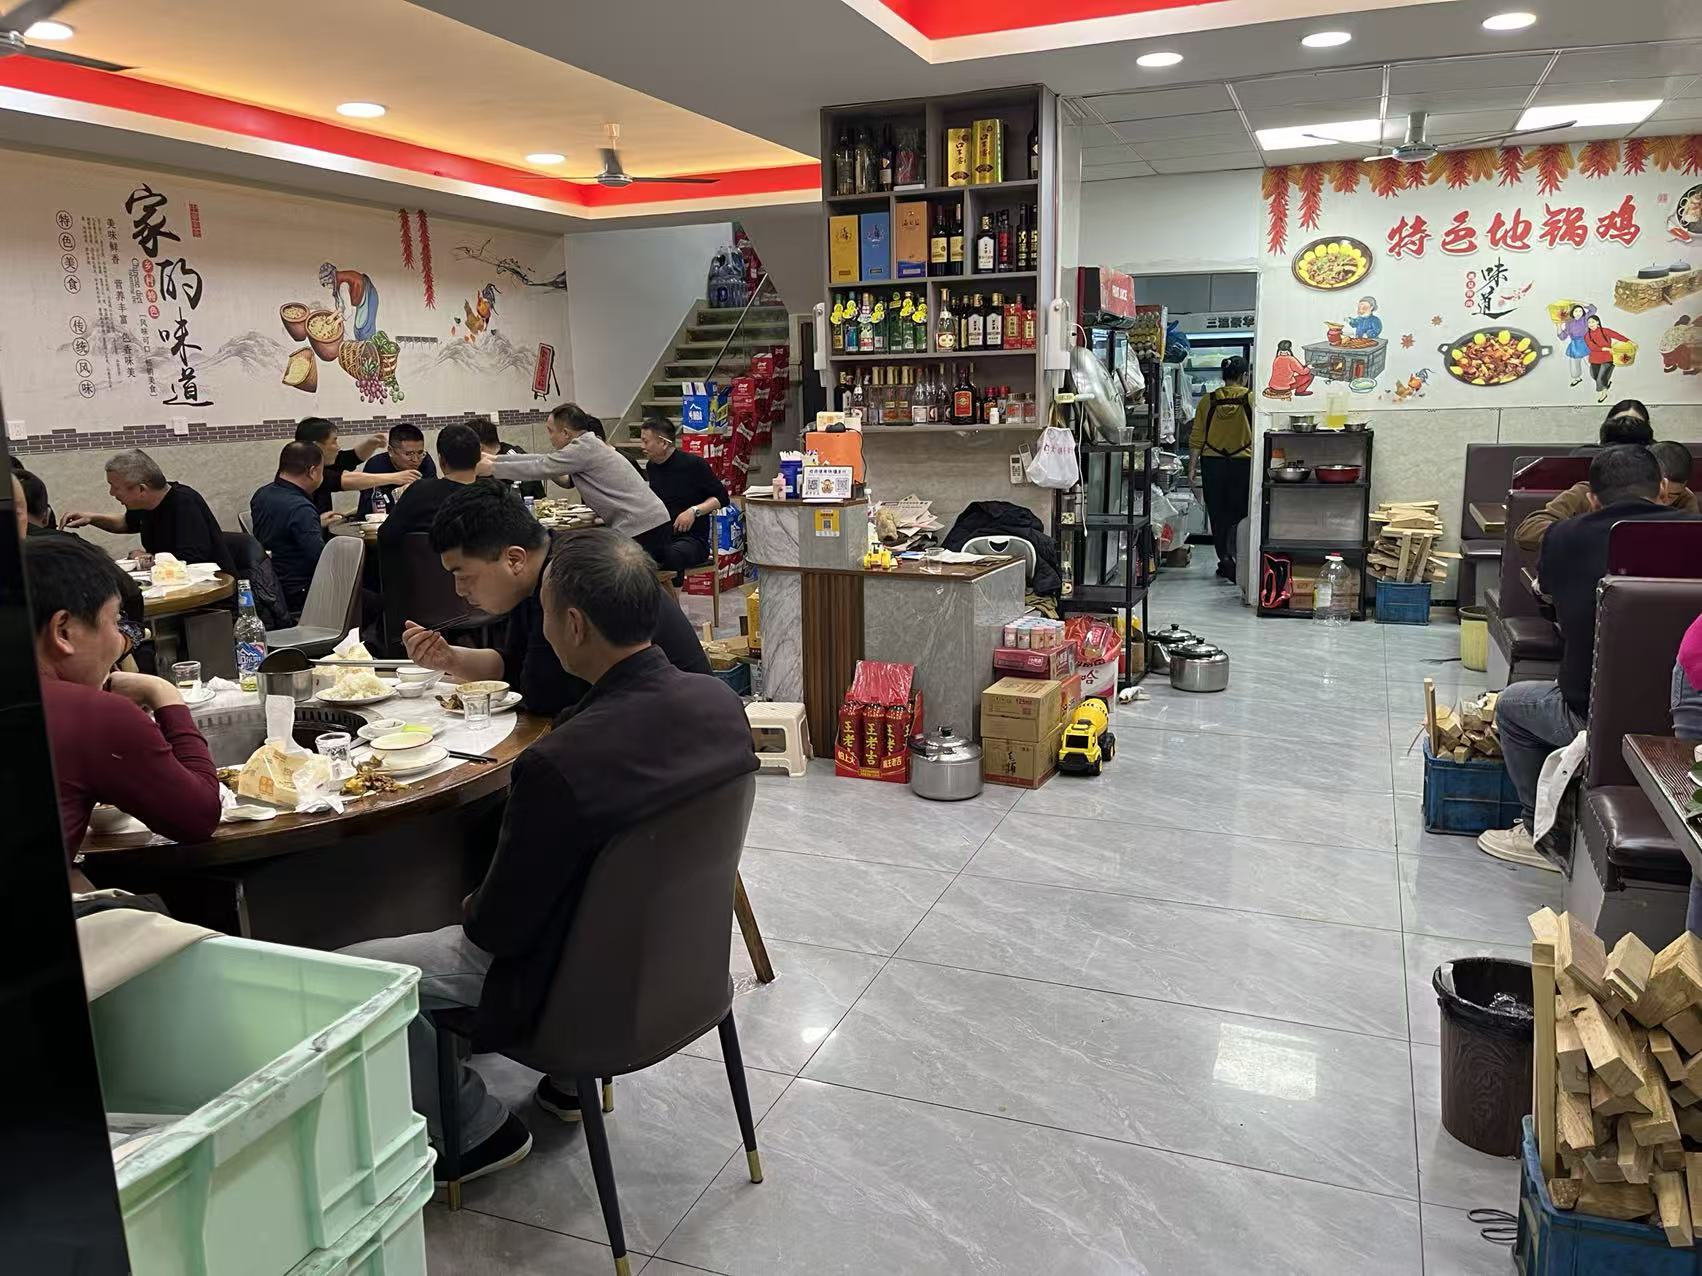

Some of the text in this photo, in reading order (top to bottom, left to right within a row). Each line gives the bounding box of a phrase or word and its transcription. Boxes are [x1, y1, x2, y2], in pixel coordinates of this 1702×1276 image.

[57, 211, 81, 293] 特色美食
[1386, 194, 1642, 258] 特色地锅鸡
[125, 183, 214, 407] 家的味道
[1471, 256, 1520, 320] 味道
[71, 317, 95, 398] 传统风味
[843, 721, 855, 752] 王老
[866, 723, 878, 765] 王老吉
